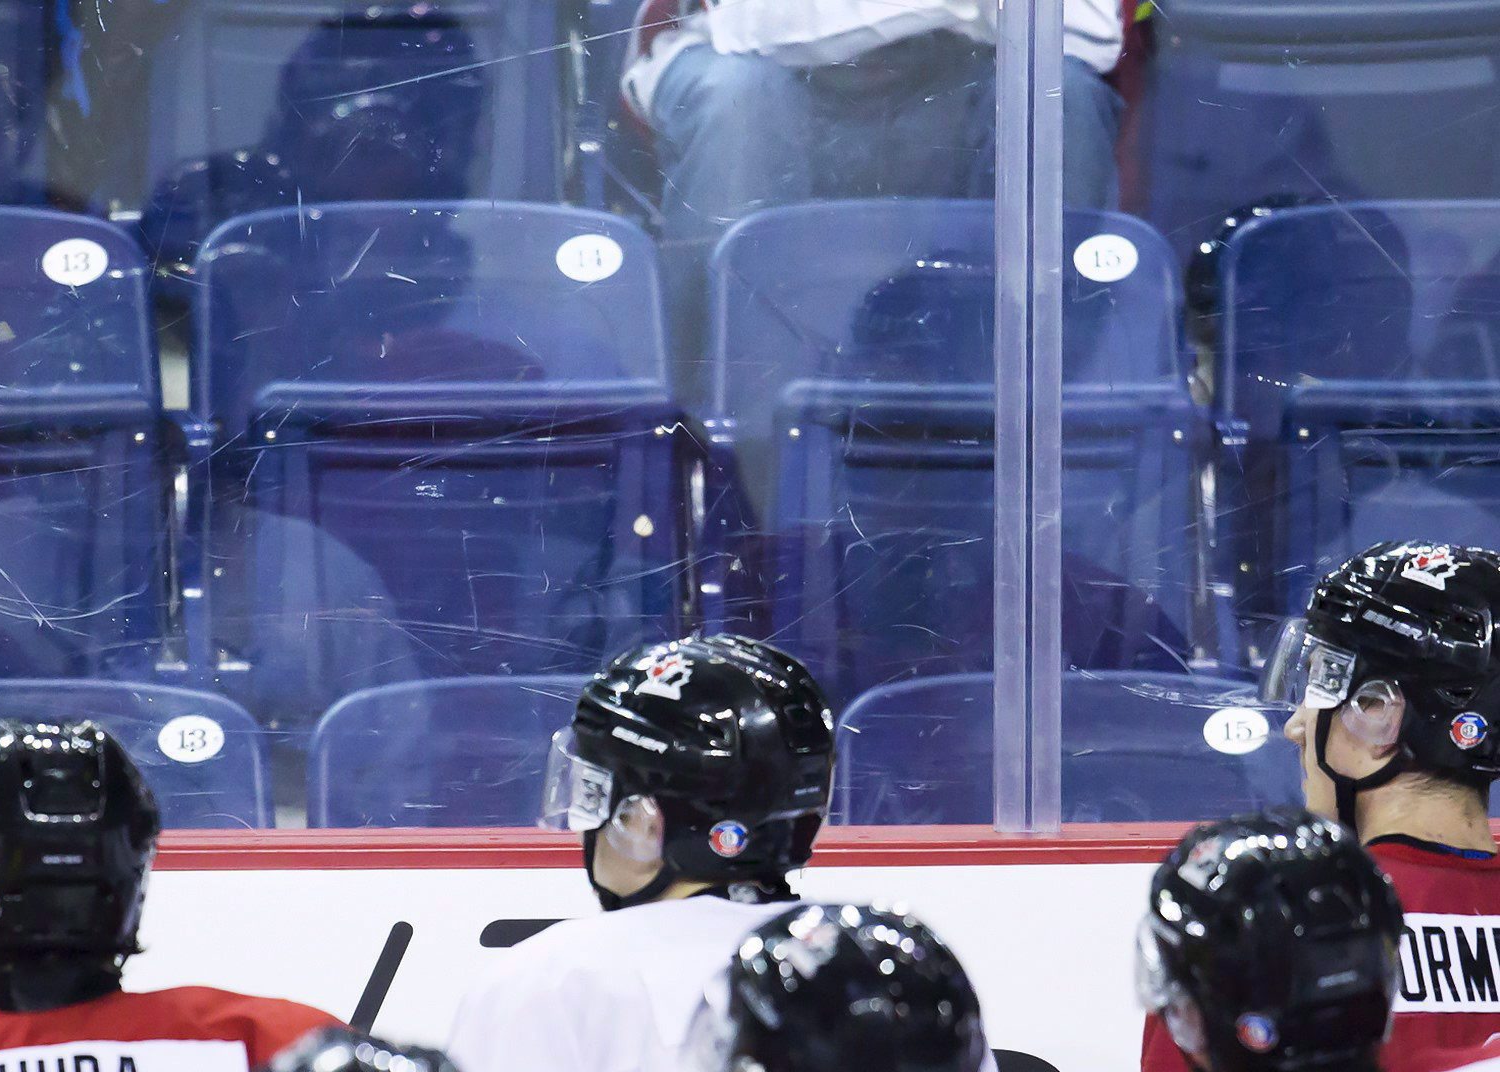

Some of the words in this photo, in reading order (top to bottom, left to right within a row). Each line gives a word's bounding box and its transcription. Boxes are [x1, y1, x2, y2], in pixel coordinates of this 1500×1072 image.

[63, 251, 91, 273] 13
[177, 729, 207, 750] 13
[1224, 721, 1253, 742] 15
[1399, 925, 1500, 1003] ORM
